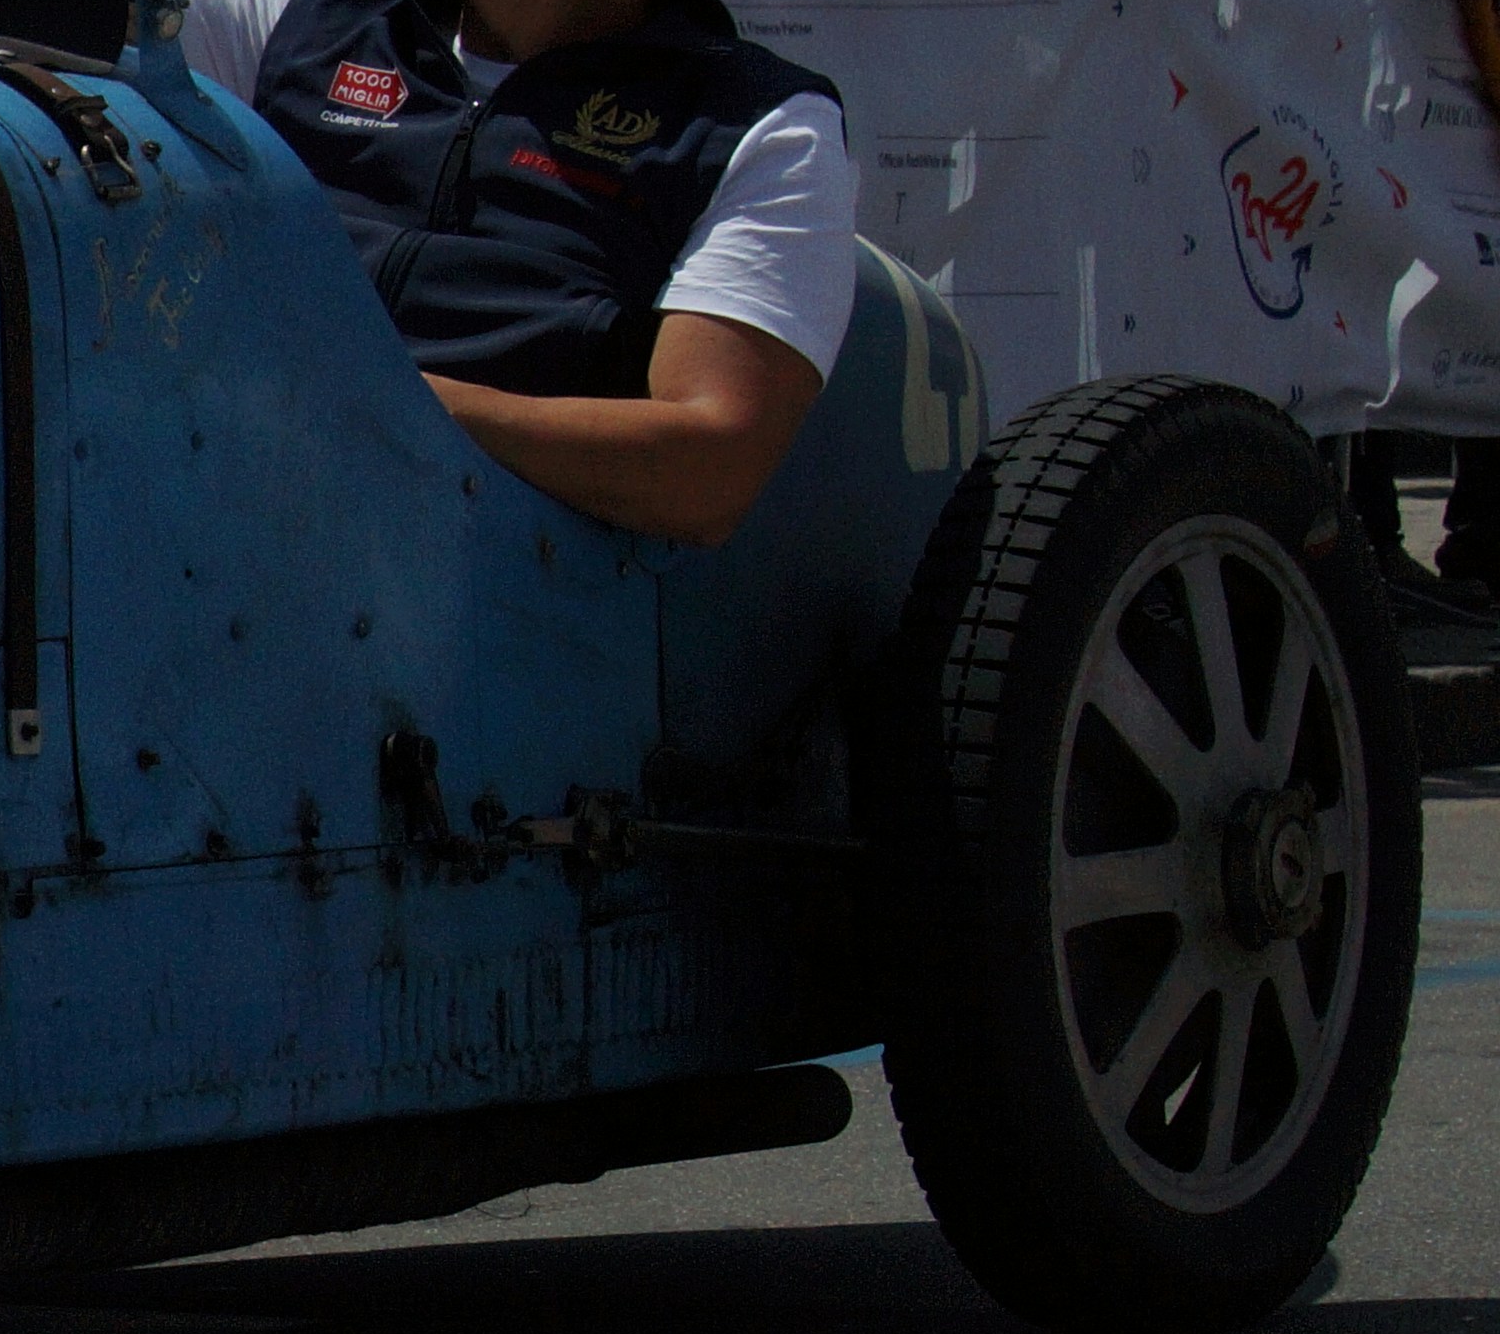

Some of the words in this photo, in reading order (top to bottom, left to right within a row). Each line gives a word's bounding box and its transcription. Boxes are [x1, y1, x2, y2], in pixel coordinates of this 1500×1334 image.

[345, 69, 392, 90] 1000
[334, 84, 391, 109] MIGLIA
[320, 110, 400, 128] COMPETIT
[593, 104, 645, 135] AD
